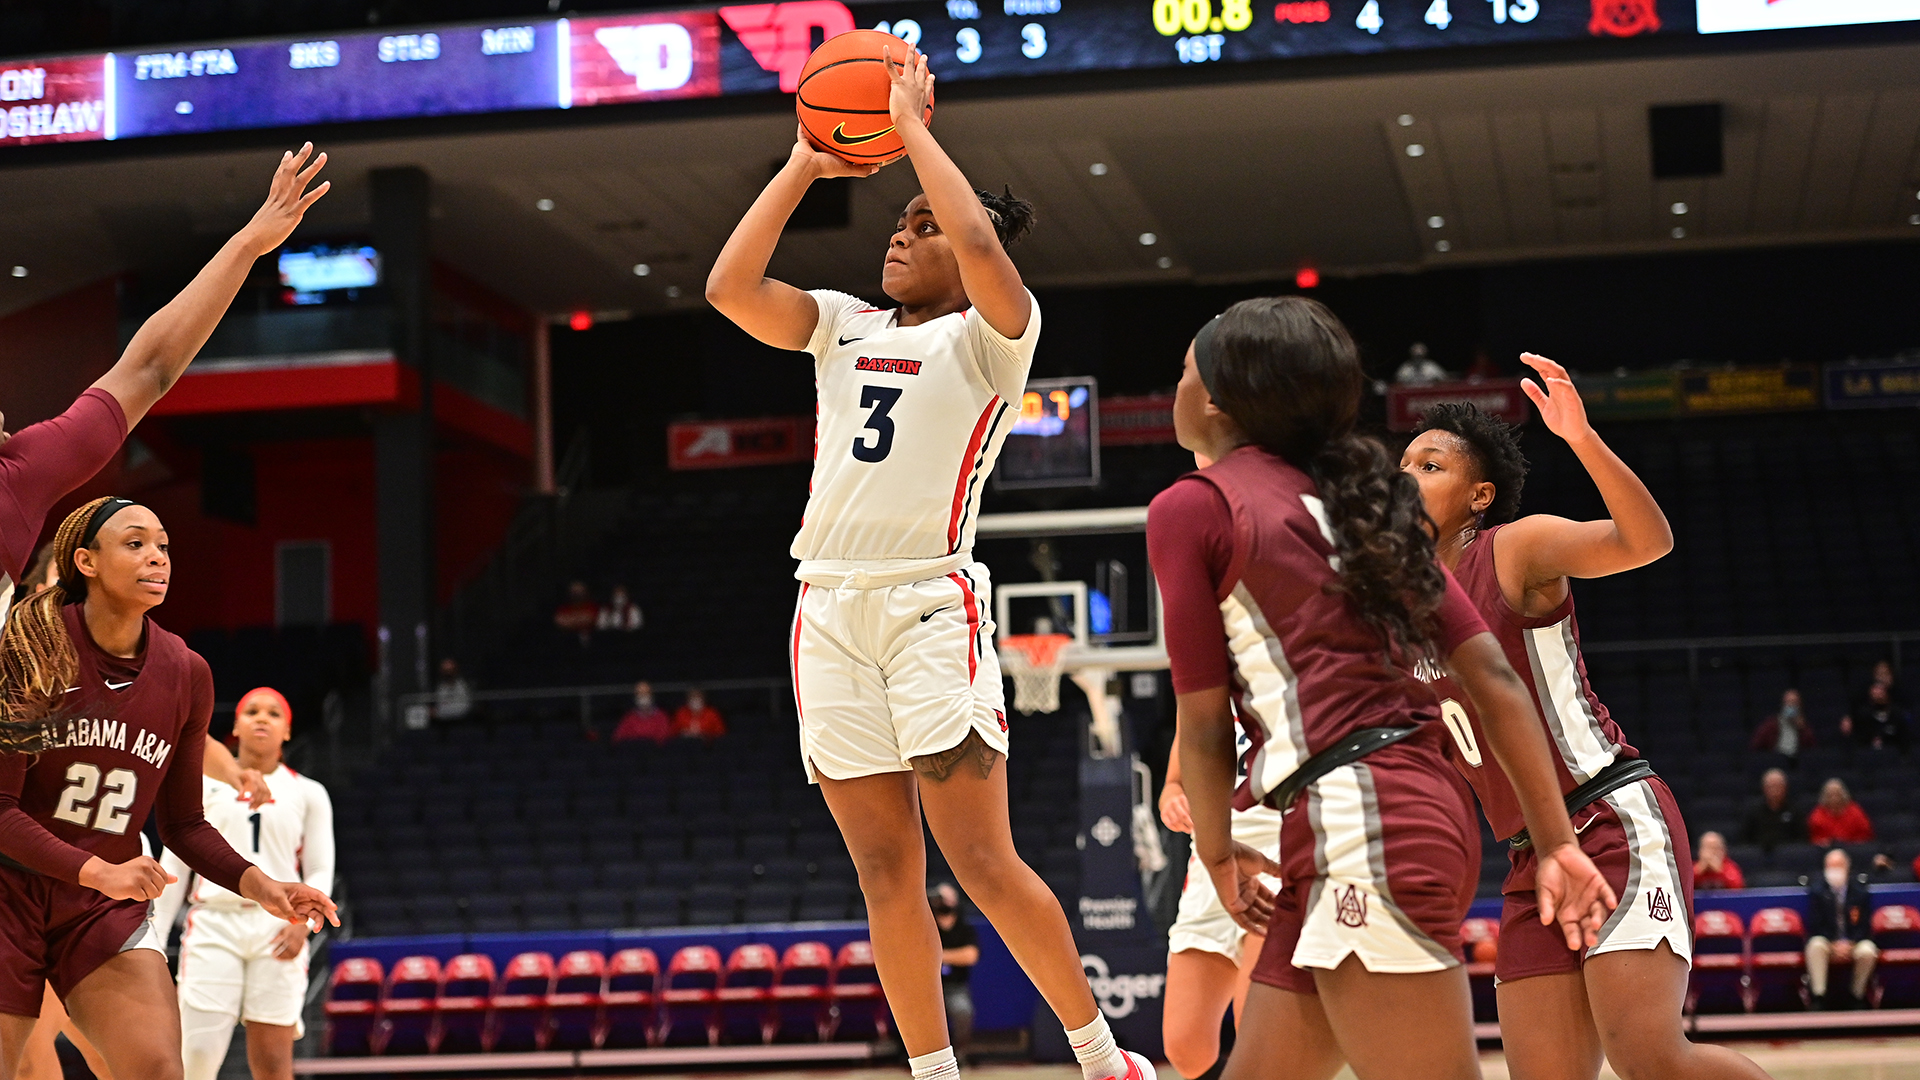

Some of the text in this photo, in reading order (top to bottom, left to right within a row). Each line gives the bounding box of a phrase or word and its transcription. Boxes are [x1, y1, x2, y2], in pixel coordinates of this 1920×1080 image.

[1356, 0, 1384, 34] 4
[1424, 0, 1452, 30] 4
[481, 26, 535, 55] MIN
[956, 27, 982, 64] 3
[1021, 23, 1048, 59] 3
[1175, 34, 1225, 63] 1ST
[855, 356, 922, 376] DAYTON
[852, 385, 903, 463] 3
[130, 728, 172, 769] A&M
[52, 761, 138, 836] 22
[249, 812, 261, 853] 1
